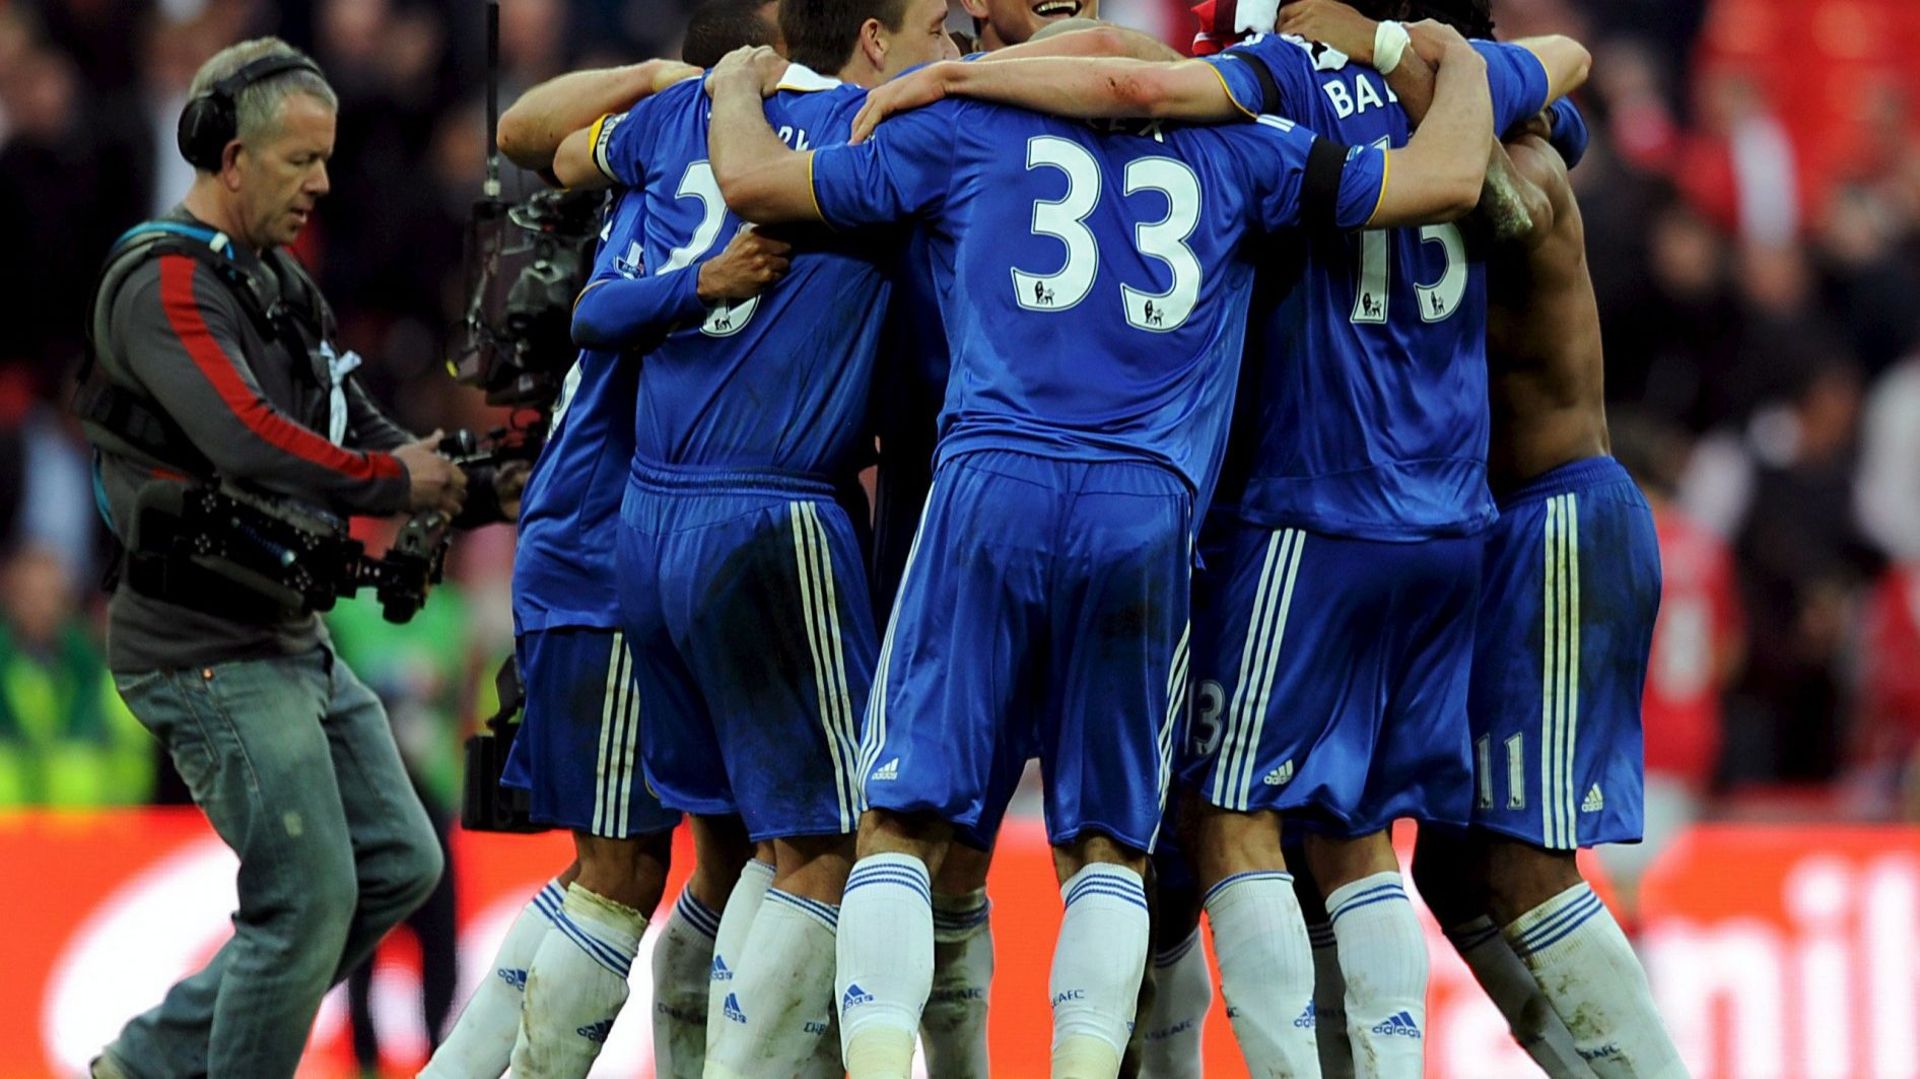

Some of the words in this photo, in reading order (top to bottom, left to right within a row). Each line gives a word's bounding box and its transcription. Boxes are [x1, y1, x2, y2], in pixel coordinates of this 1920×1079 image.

[1011, 135, 1203, 333] 33
[1475, 732, 1525, 810] 11
[1372, 1023, 1422, 1039] adidas
